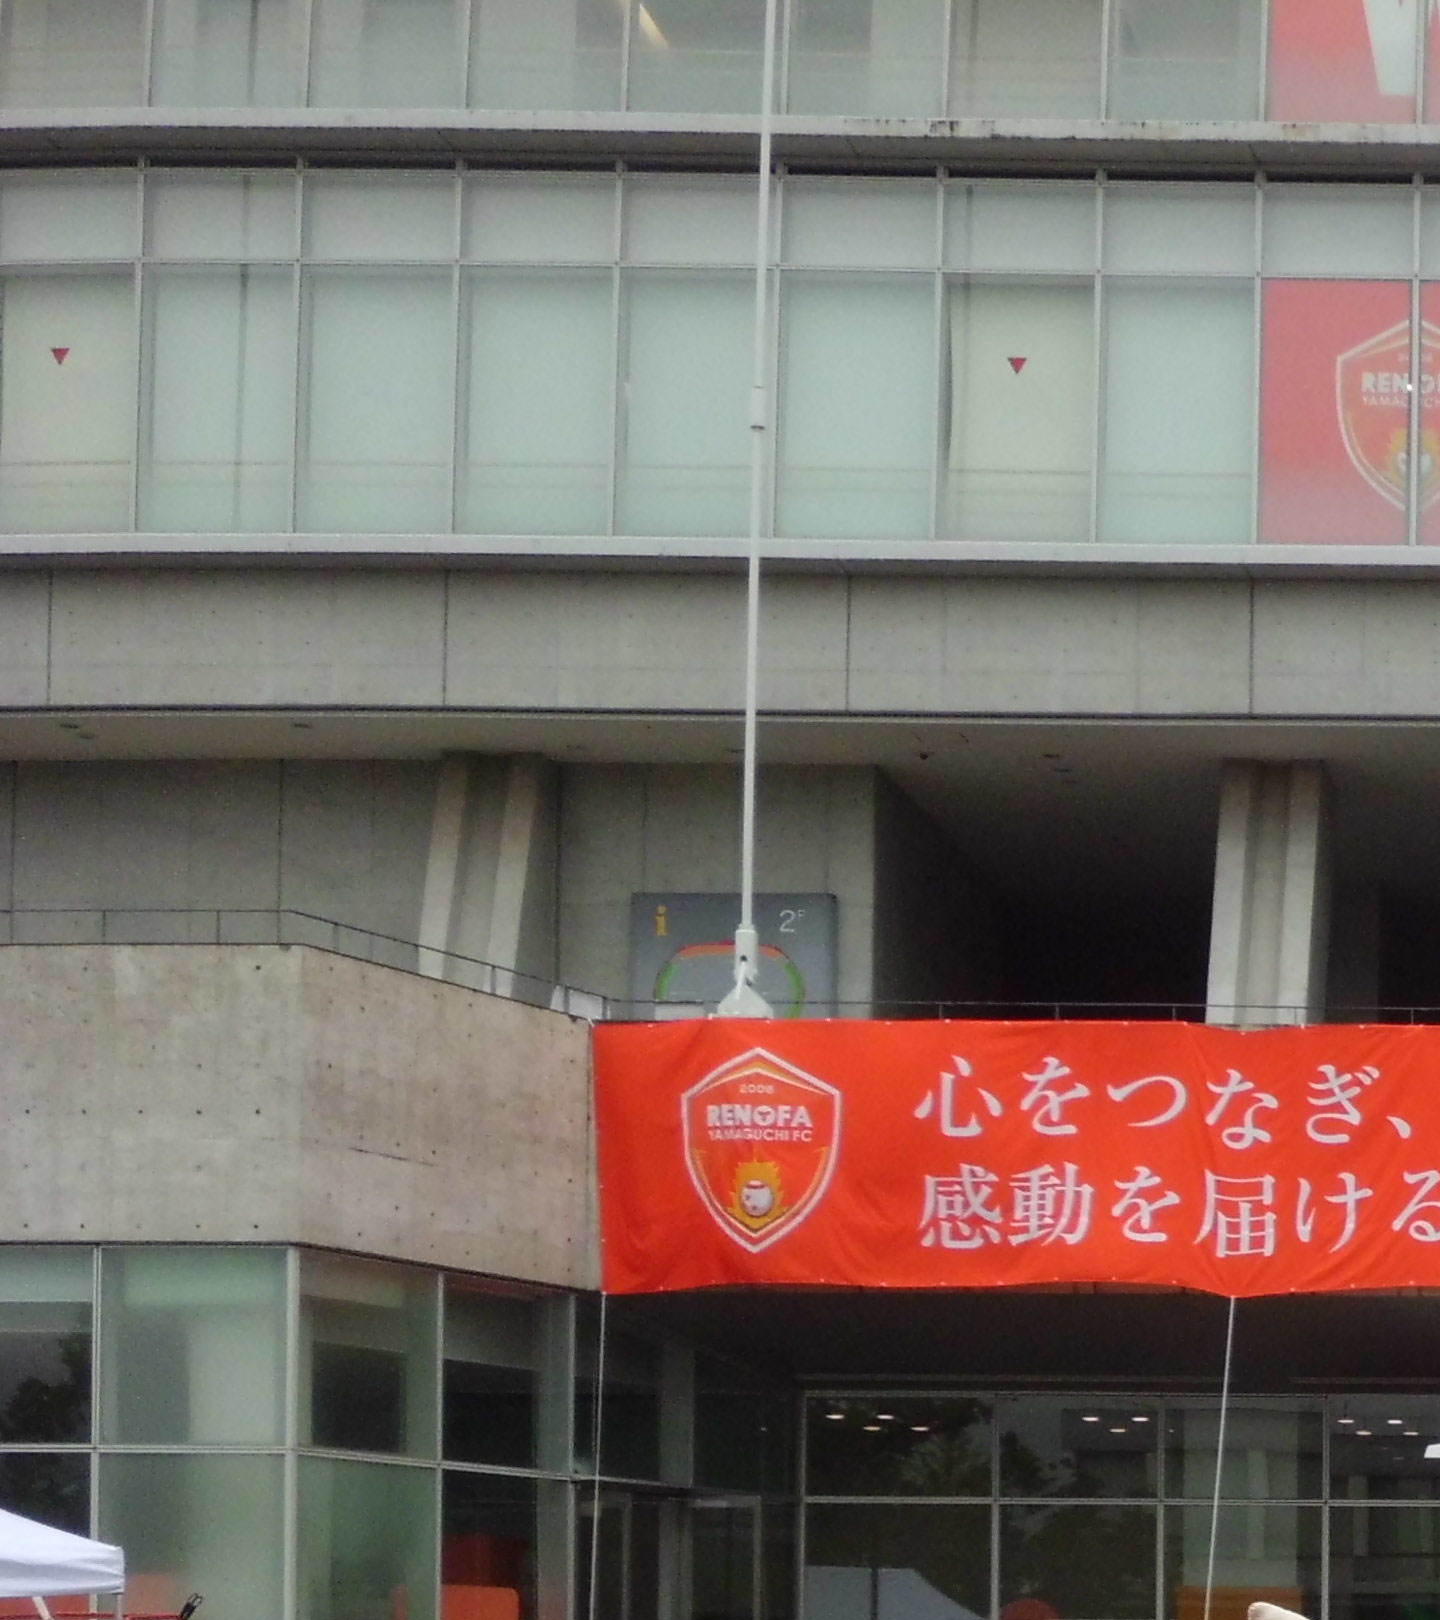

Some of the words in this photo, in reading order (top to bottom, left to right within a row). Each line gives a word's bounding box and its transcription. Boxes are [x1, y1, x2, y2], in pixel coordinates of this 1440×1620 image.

[913, 1053, 1412, 1151] 心をつなぎ、
[706, 1104, 813, 1127] RENOFA
[708, 1128, 789, 1141] YAMAGUCHI
[792, 1130, 812, 1142] FC
